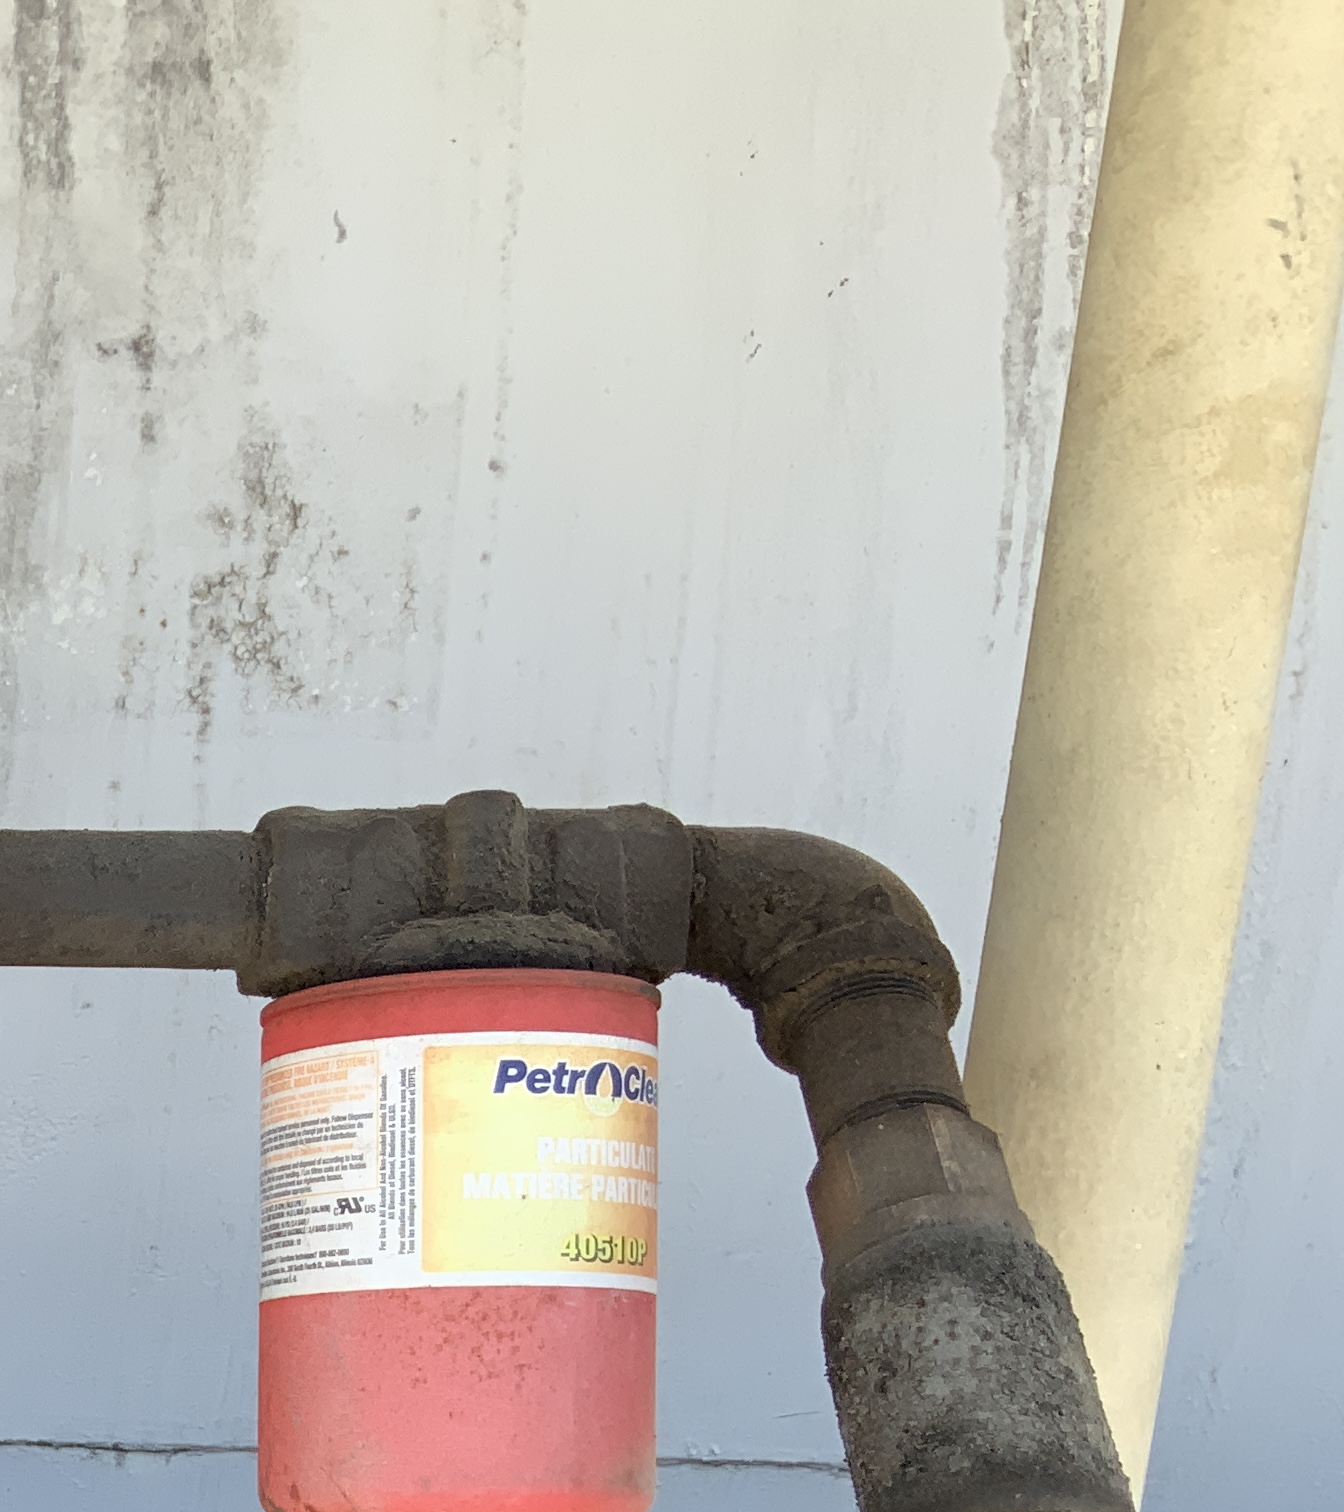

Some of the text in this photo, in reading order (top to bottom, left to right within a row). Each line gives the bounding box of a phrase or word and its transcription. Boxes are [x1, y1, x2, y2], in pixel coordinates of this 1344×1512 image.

[398, 1089, 407, 1103] sans
[398, 1115, 407, 1128] avec
[408, 1126, 416, 1134] de
[398, 1131, 407, 1158] essences
[398, 1160, 407, 1169] les
[379, 1173, 387, 1184] And
[408, 1158, 416, 1187] carburant
[379, 1186, 387, 1208] Alcohol
[388, 1190, 396, 1209] Blends
[398, 1193, 407, 1206] dans
[365, 1205, 375, 1213] US
[379, 1210, 387, 1218] All
[379, 1228, 387, 1239] Use
[408, 1229, 416, 1238] les
[379, 1241, 387, 1250] For
[408, 1240, 416, 1254] Tous
